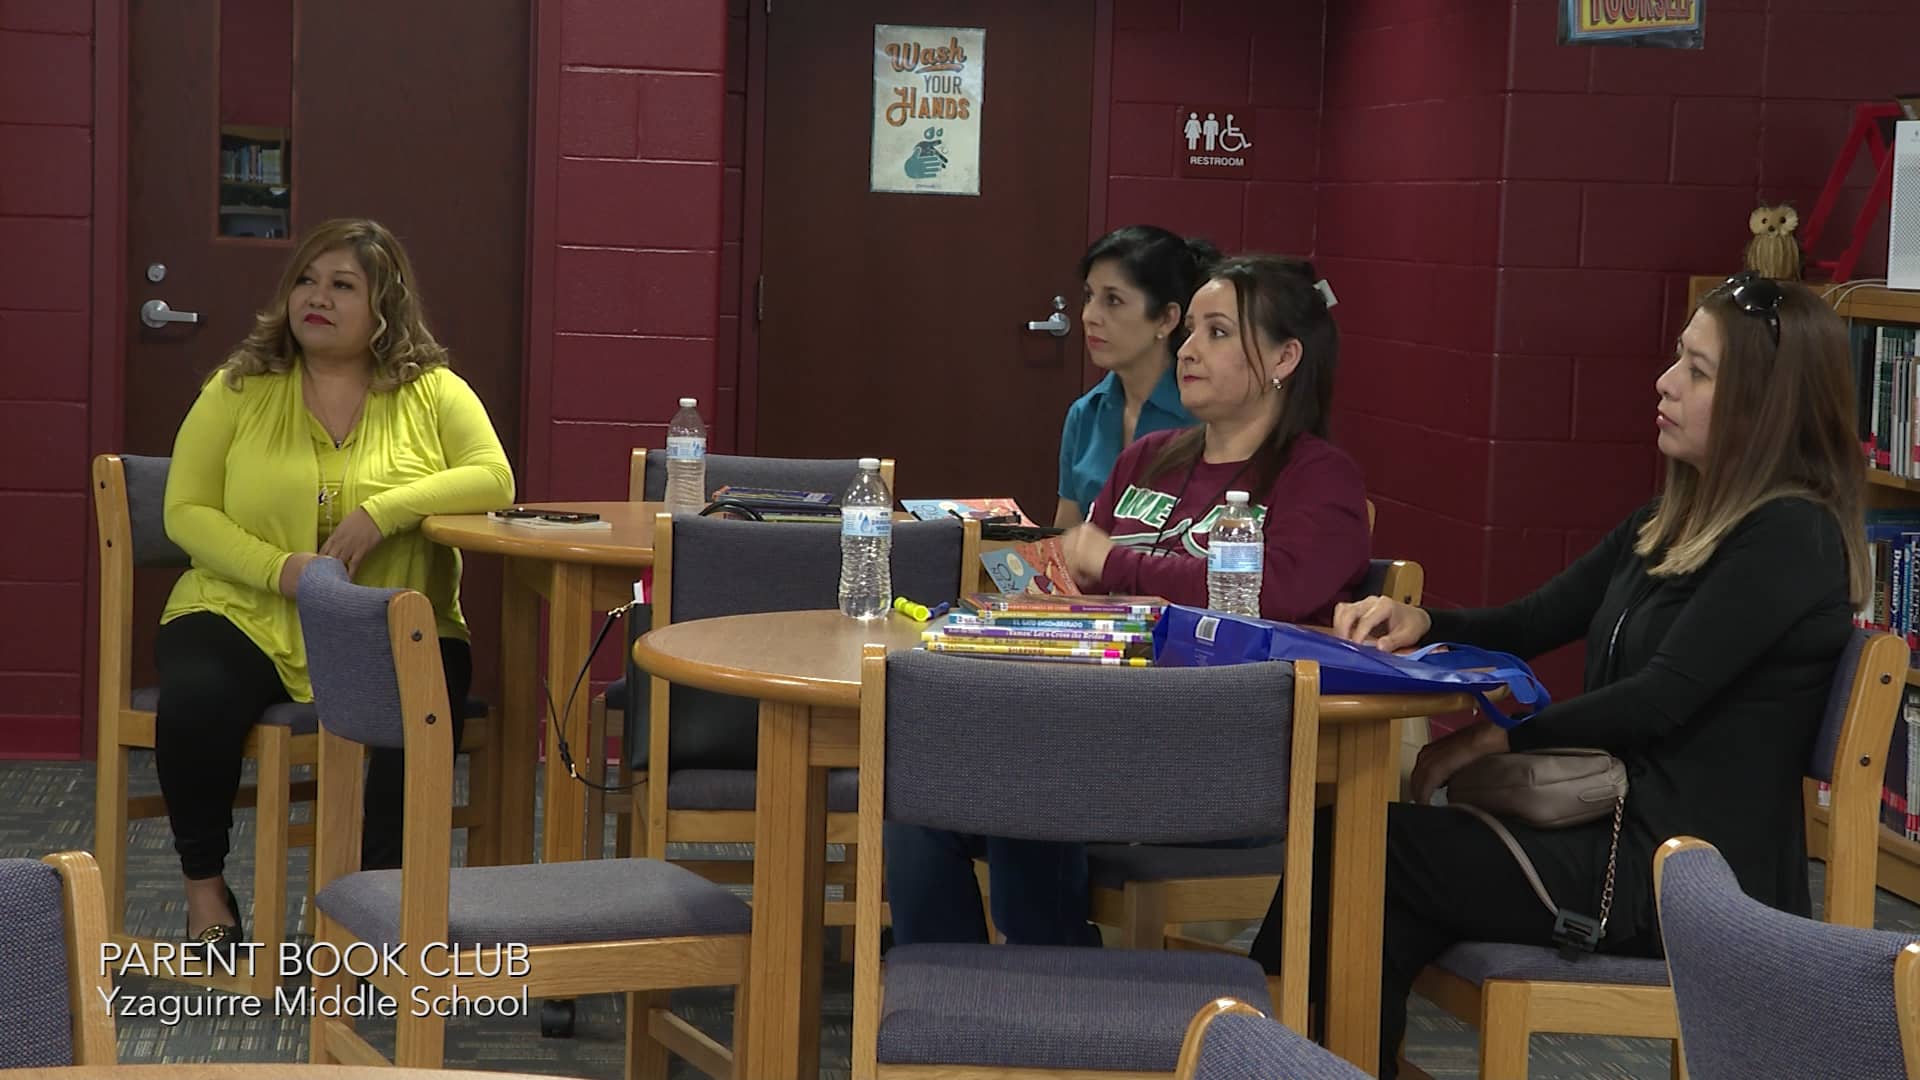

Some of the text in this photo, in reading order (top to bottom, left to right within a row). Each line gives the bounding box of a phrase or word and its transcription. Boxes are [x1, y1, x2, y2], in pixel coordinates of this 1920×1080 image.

[885, 37, 967, 72] Wash
[924, 75, 963, 95] YOUR
[1190, 156, 1244, 166] RESTROOM
[1113, 484, 1181, 529] WE
[1890, 550, 1902, 614] Dictionary
